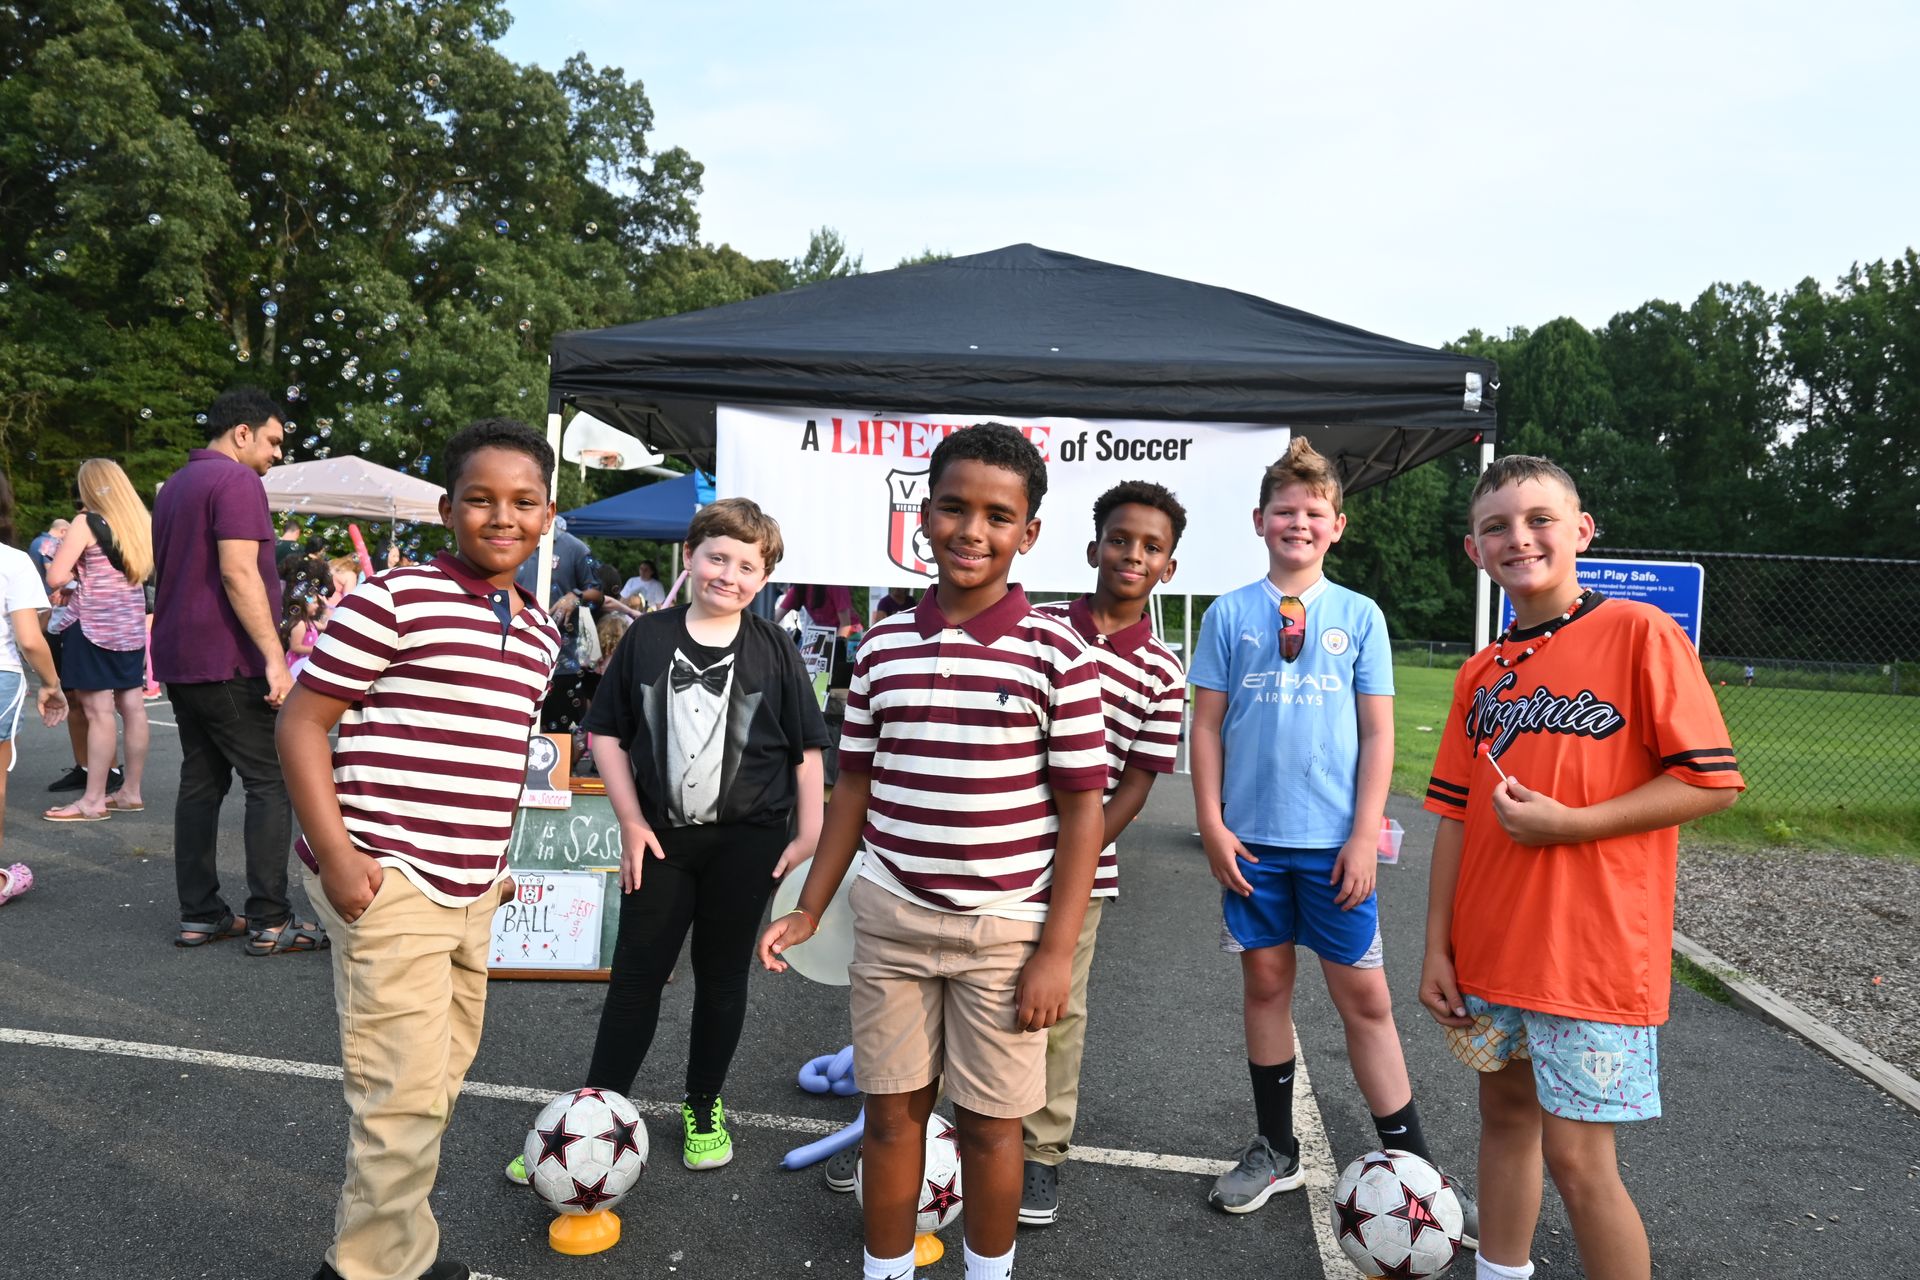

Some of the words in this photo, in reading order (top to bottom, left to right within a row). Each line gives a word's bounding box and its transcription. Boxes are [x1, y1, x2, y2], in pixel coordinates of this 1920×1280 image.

[801, 420, 819, 451] A
[831, 418, 1050, 462] LIFETE
[1060, 431, 1088, 462] of
[1096, 429, 1193, 461] Soccer
[1604, 570, 1628, 582] Play
[1631, 571, 1659, 582] Safe.
[1242, 671, 1342, 691] ETIHAD
[1255, 693, 1323, 706] AIRWAYS
[1466, 671, 1626, 762] Virginia
[543, 822, 556, 839] is
[538, 842, 554, 861] in
